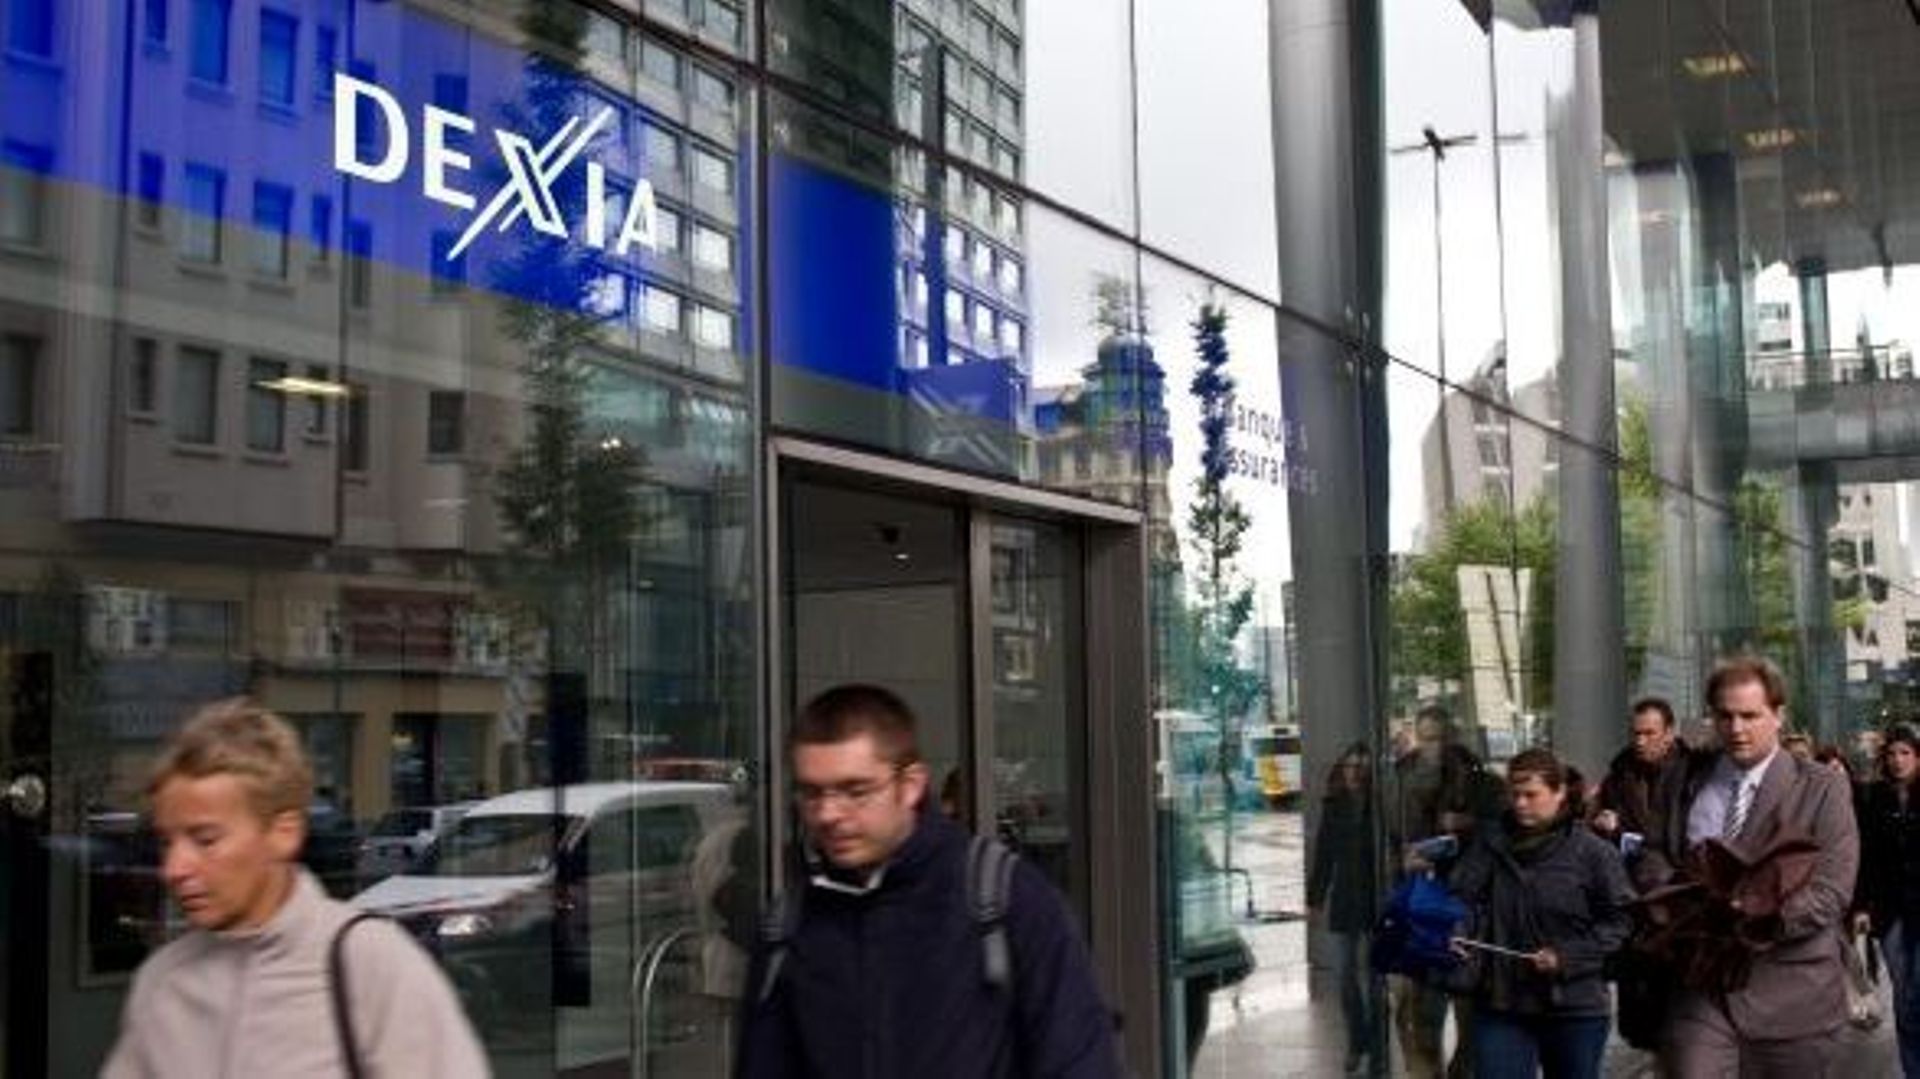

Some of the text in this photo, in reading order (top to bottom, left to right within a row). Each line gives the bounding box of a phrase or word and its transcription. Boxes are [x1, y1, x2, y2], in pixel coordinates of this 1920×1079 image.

[335, 72, 658, 261] DEXIA
[1226, 393, 1294, 449] anque
[1225, 446, 1318, 497] ssurances
